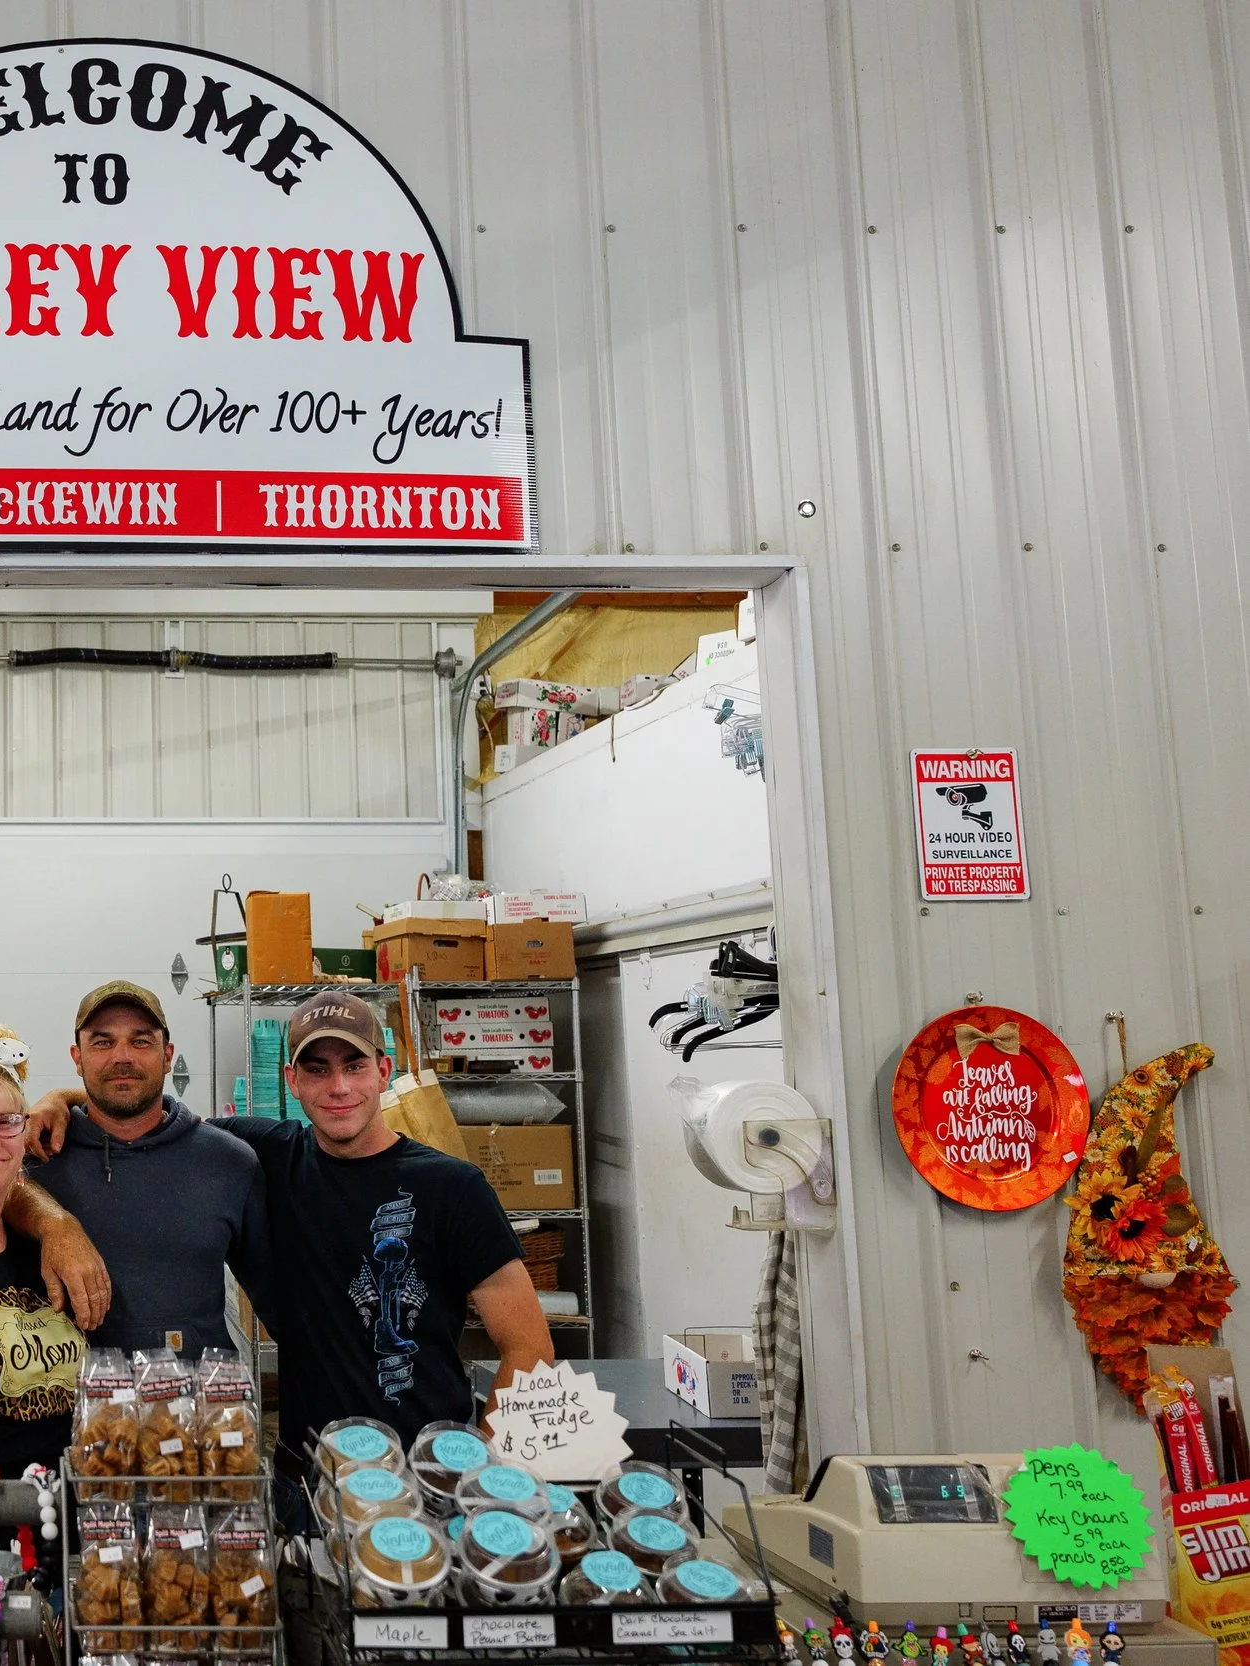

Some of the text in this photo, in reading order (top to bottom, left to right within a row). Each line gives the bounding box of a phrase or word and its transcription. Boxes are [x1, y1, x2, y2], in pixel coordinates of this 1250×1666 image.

[55, 152, 130, 204] TO
[156, 244, 425, 343] VIEW
[68, 387, 153, 456] for
[165, 387, 261, 433] Over
[268, 390, 366, 431] 100+
[371, 396, 503, 465] Years!
[257, 482, 501, 530] THORNTON
[920, 759, 1010, 779] WARNING
[928, 832, 1012, 843] 24 HOUR VIDEO
[932, 849, 1012, 859] SURVEILLANCE
[925, 866, 1021, 879] PRIVATE PROPERTY
[931, 879, 1017, 892] NO TRESPASSING
[300, 1005, 356, 1027] STIHL
[477, 1010, 509, 1019] TOMATOES
[482, 1033, 514, 1042] TOMATOES
[952, 1056, 1015, 1088] Leaves
[969, 1083, 1037, 1115] falling
[936, 1111, 1026, 1143] Autumn
[945, 1136, 1031, 1171] is calling
[10, 1333, 81, 1373] Mom
[517, 1371, 563, 1393] Local
[499, 1391, 584, 1417] Homemade
[1165, 1401, 1185, 1420] slim jim
[529, 1409, 594, 1433] Fudge
[1172, 1424, 1184, 1434] 6g
[1196, 1421, 1214, 1473] ORIGINAL
[1179, 1443, 1194, 1493] ORIGINAL
[1081, 1492, 1114, 1501] each
[1180, 1492, 1249, 1513] ORIAL
[1036, 1509, 1129, 1535] Key Chains
[1099, 1540, 1131, 1551] each
[1181, 1523, 1248, 1556] slim
[1050, 1550, 1096, 1570] pencils
[1202, 1546, 1250, 1582] jim
[472, 1618, 541, 1630] Chocolate
[618, 1613, 707, 1625] Dark Chocolate
[1211, 1620, 1222, 1629] 6g
[375, 1624, 431, 1643] Maple
[470, 1631, 554, 1645] Peanut Butter
[667, 1625, 687, 1637] Sea
[691, 1625, 718, 1636] Salt
[1224, 1631, 1247, 1643] ARTIFICIAL
